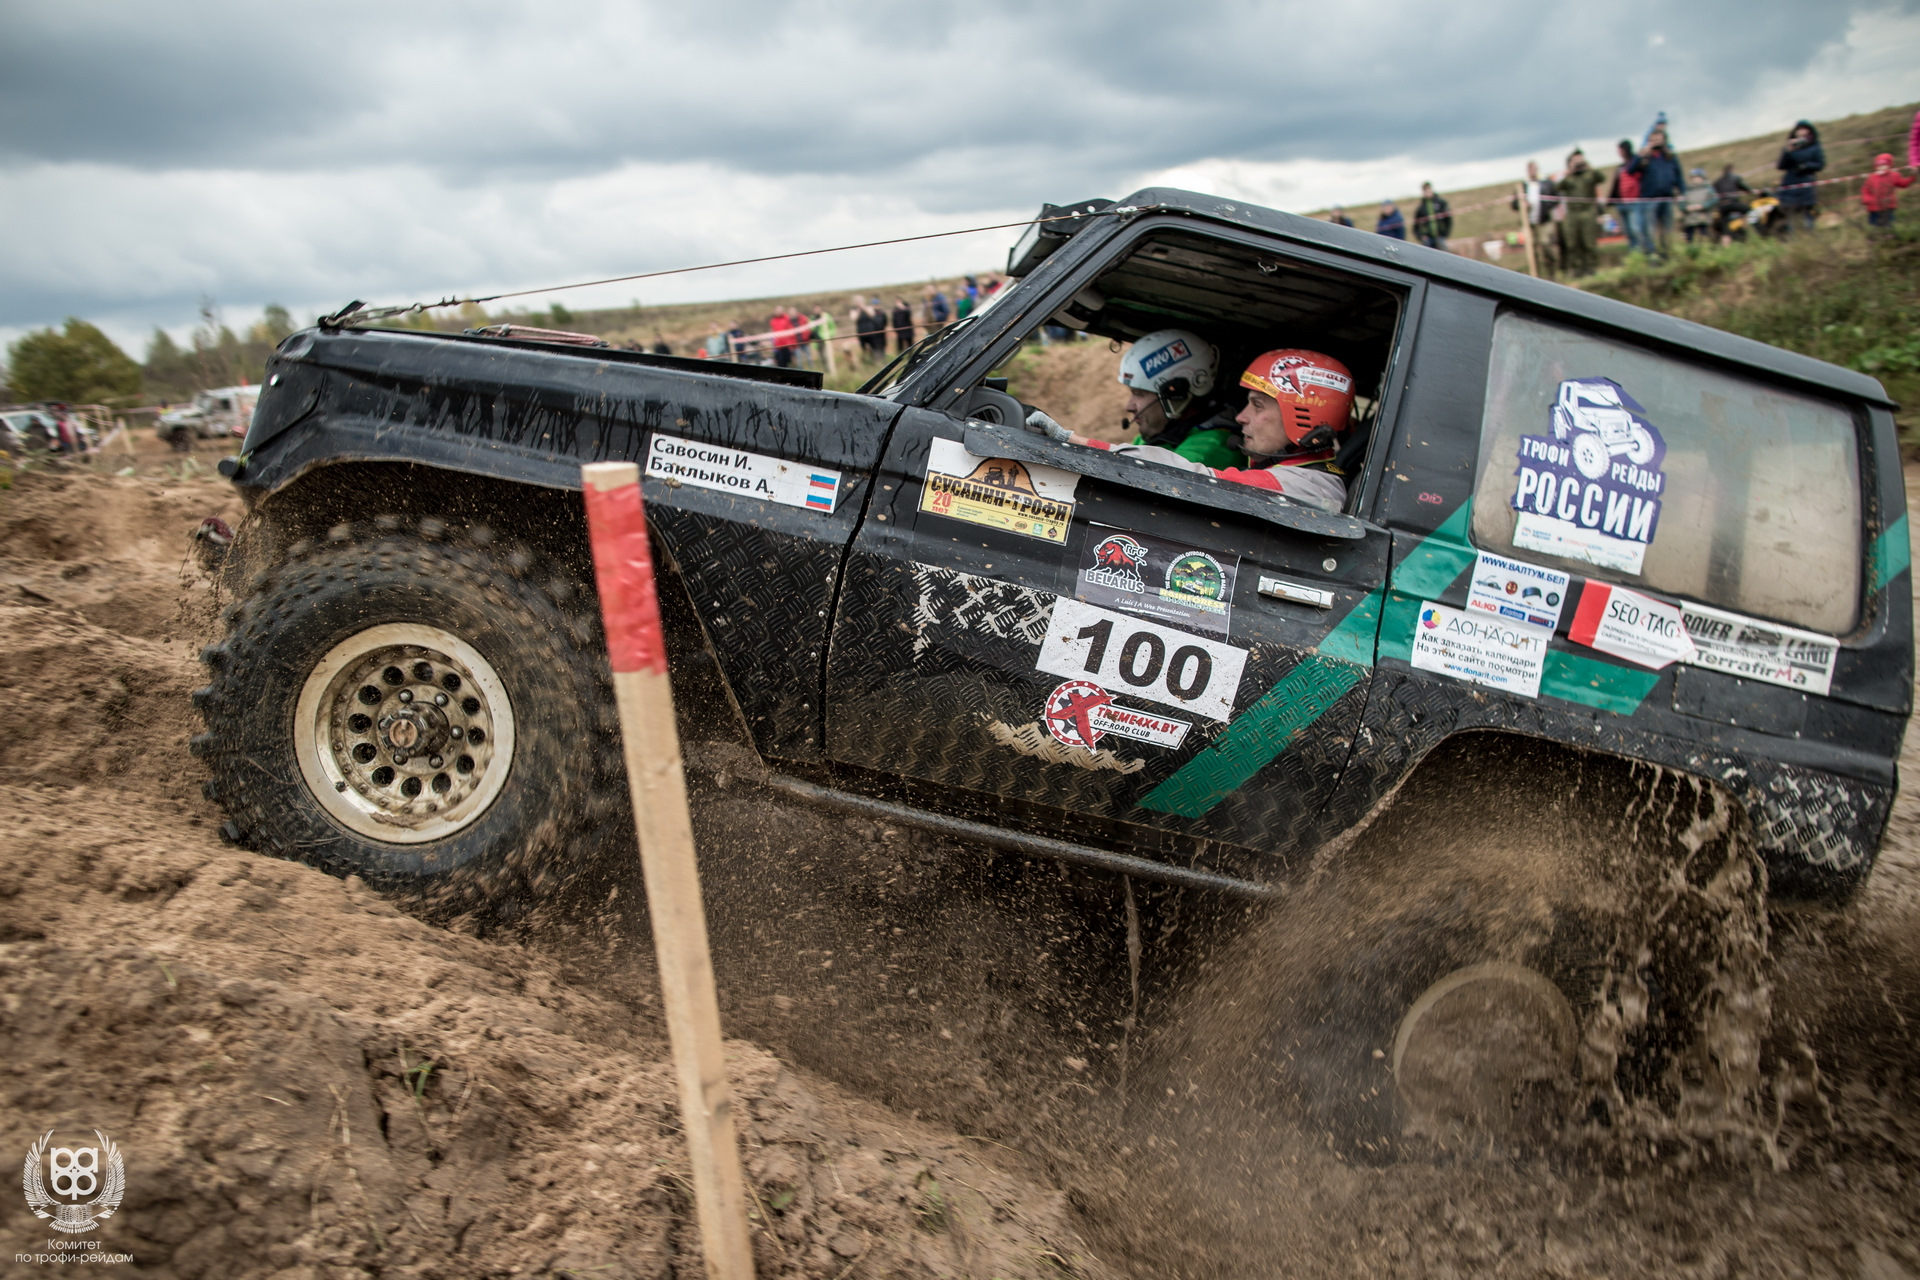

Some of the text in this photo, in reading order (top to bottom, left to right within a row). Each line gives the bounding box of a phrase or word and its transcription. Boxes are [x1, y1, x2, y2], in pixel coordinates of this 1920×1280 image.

[653, 437, 752, 471] Савосин И.
[1522, 438, 1570, 467] ТРОФИ
[650, 455, 775, 494] Баклыков А.
[1611, 462, 1662, 493] РЕЙДЫ
[931, 475, 1068, 521] СУСАНИН-ТРОФИ
[932, 491, 952, 508] 20
[1516, 467, 1655, 542] РОССИИ
[1086, 569, 1145, 593] BELARUS
[1481, 555, 1565, 585] WWW.ВАЛТУМ.БЕЛ
[1159, 588, 1227, 609] RAINFOREST
[1608, 599, 1640, 625] SEO
[1422, 632, 1537, 668] Как заказать календари
[1446, 617, 1542, 652] ДОНАРИТ
[1683, 612, 1830, 664] ROVER LAND
[1077, 619, 1213, 701] 100
[1416, 642, 1539, 680] На этом сайте посмотри!
[1444, 663, 1508, 683] www.donarit.com
[1093, 719, 1151, 738] OFF-ROAD CLUB
